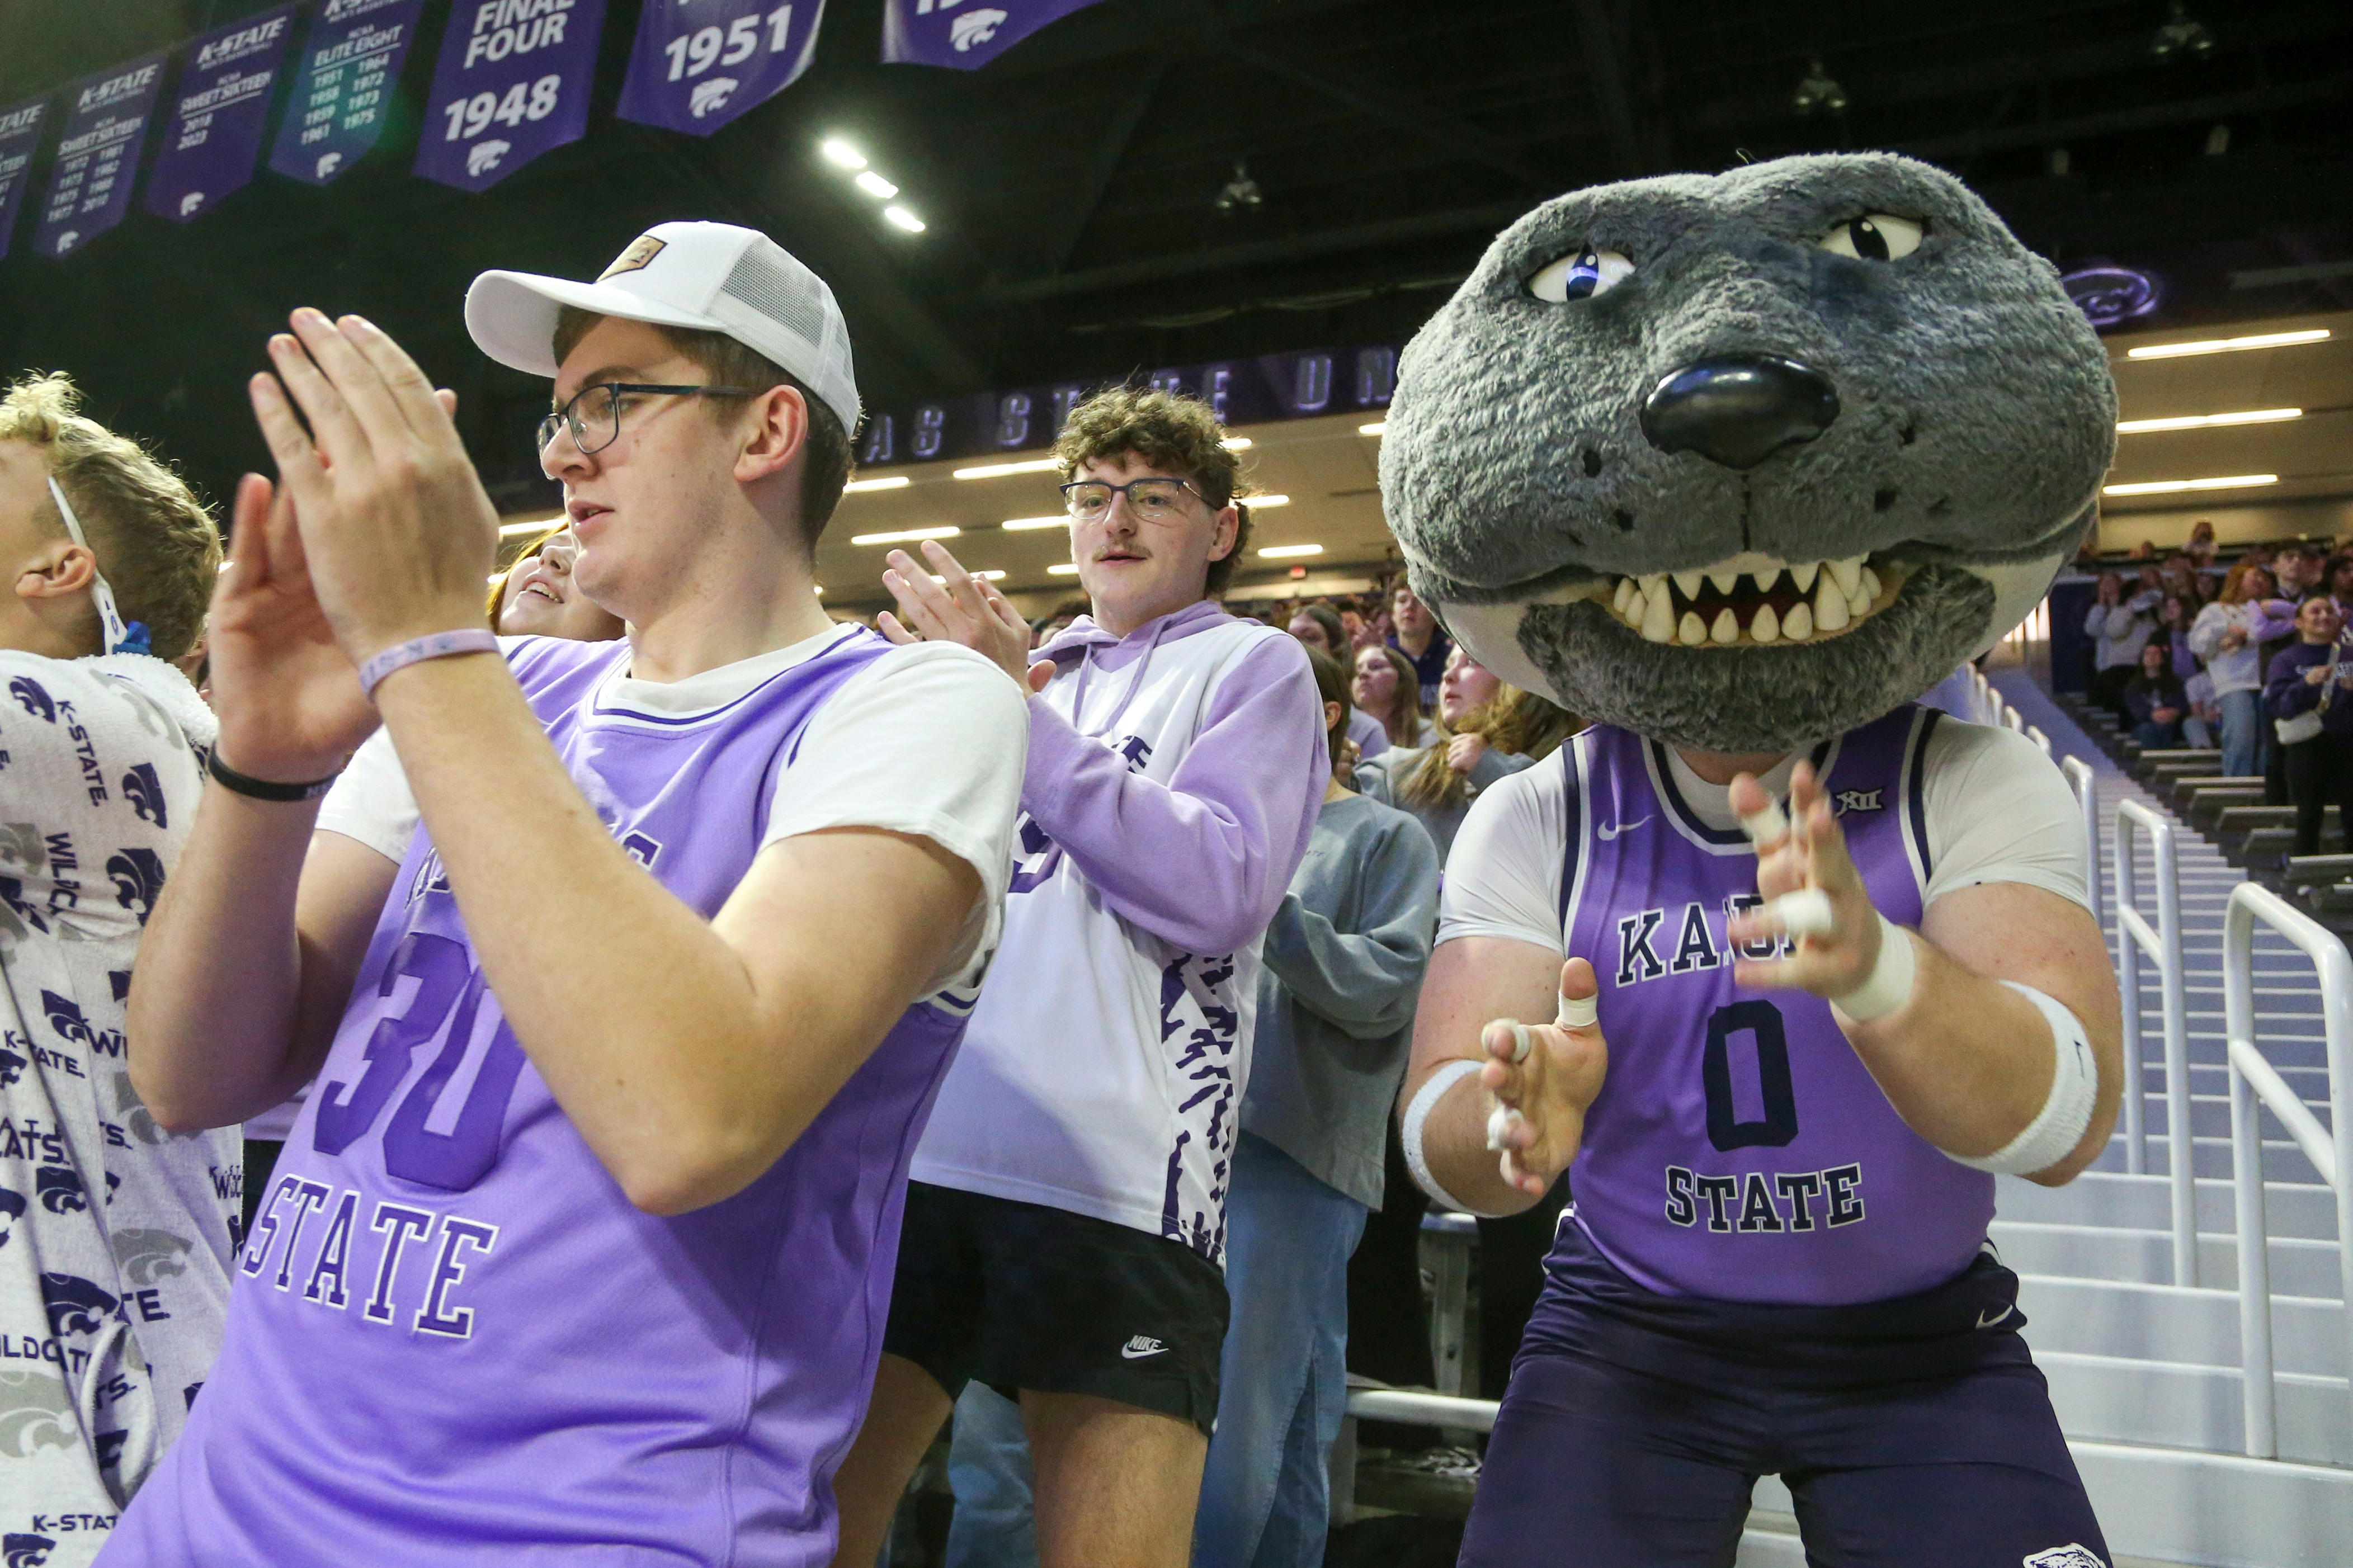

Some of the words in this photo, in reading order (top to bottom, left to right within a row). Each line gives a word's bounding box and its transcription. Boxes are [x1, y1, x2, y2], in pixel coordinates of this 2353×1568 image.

[197, 16, 287, 64] K-STATE
[313, 41, 355, 67] ELITE
[355, 23, 404, 54] EIGHT
[463, 12, 568, 69] FOUR
[665, 4, 793, 81] 1951
[78, 63, 159, 108] K-STATE
[445, 74, 561, 141] 1948
[56, 700, 109, 806] K-STATE
[314, 932, 526, 1192] 30
[1702, 999, 1799, 1152] 0
[1664, 1161, 1866, 1234] STATE
[241, 1174, 499, 1339] STATE
[1128, 1335, 1162, 1351] NIKE
[32, 1514, 118, 1532] K-STAT
